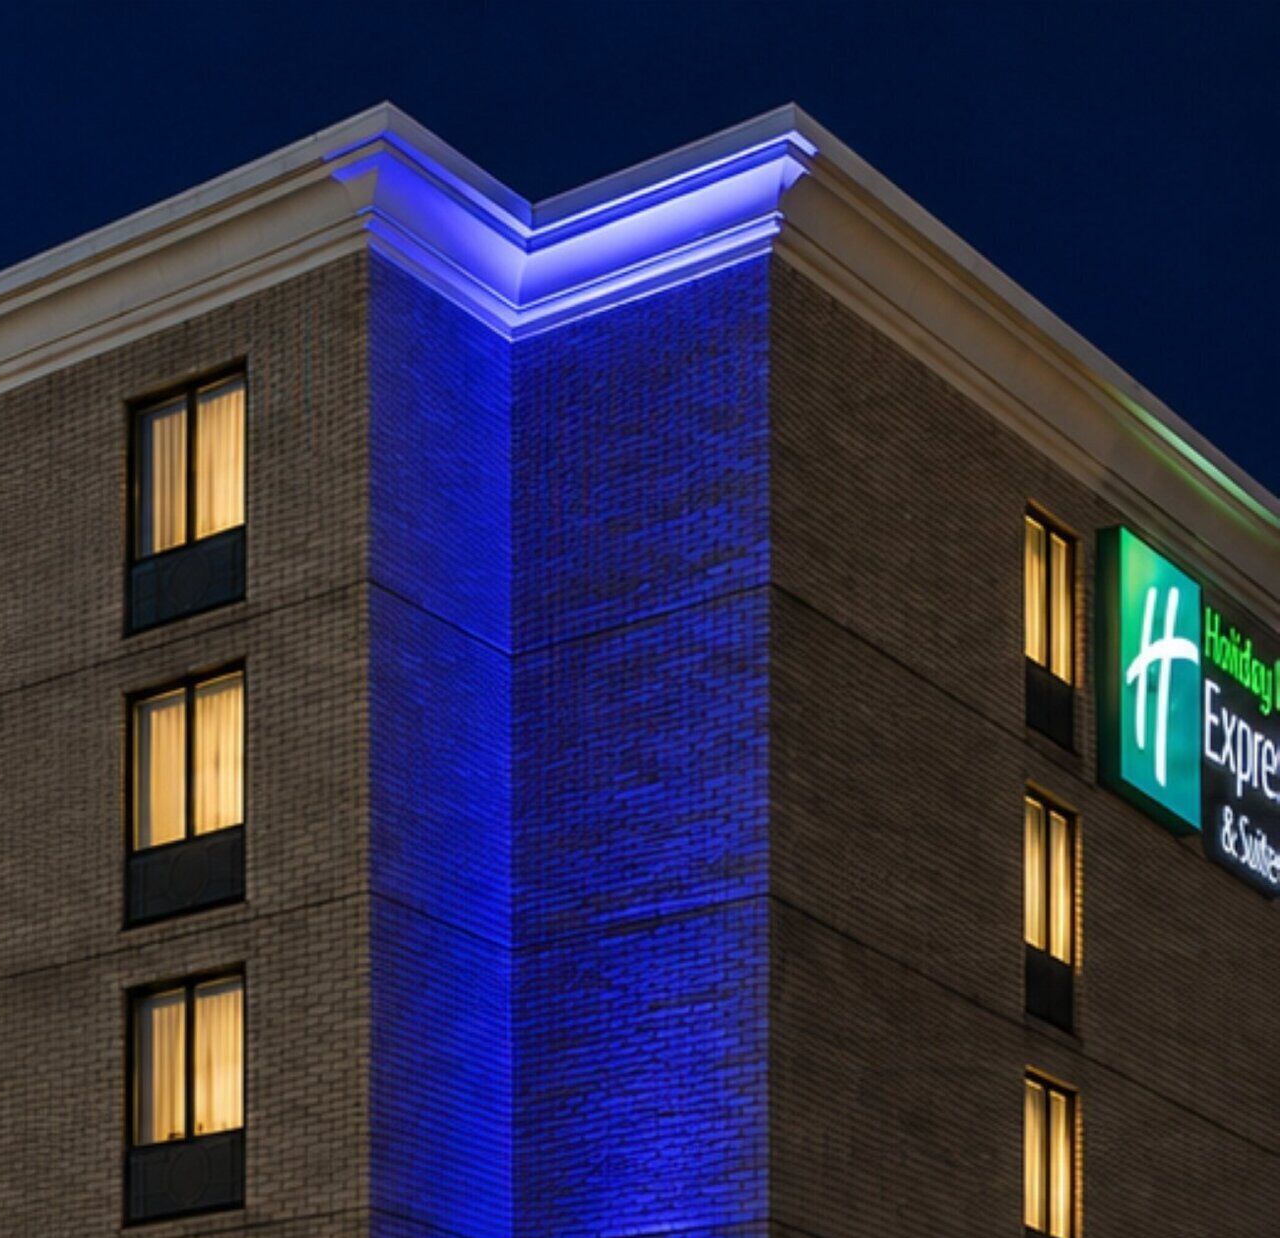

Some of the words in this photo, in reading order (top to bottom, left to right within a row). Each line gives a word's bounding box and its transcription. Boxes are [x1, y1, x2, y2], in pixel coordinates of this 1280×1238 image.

[1205, 607, 1272, 715] Holiday
[1205, 678, 1280, 801] Expre
[1222, 806, 1238, 857] &
